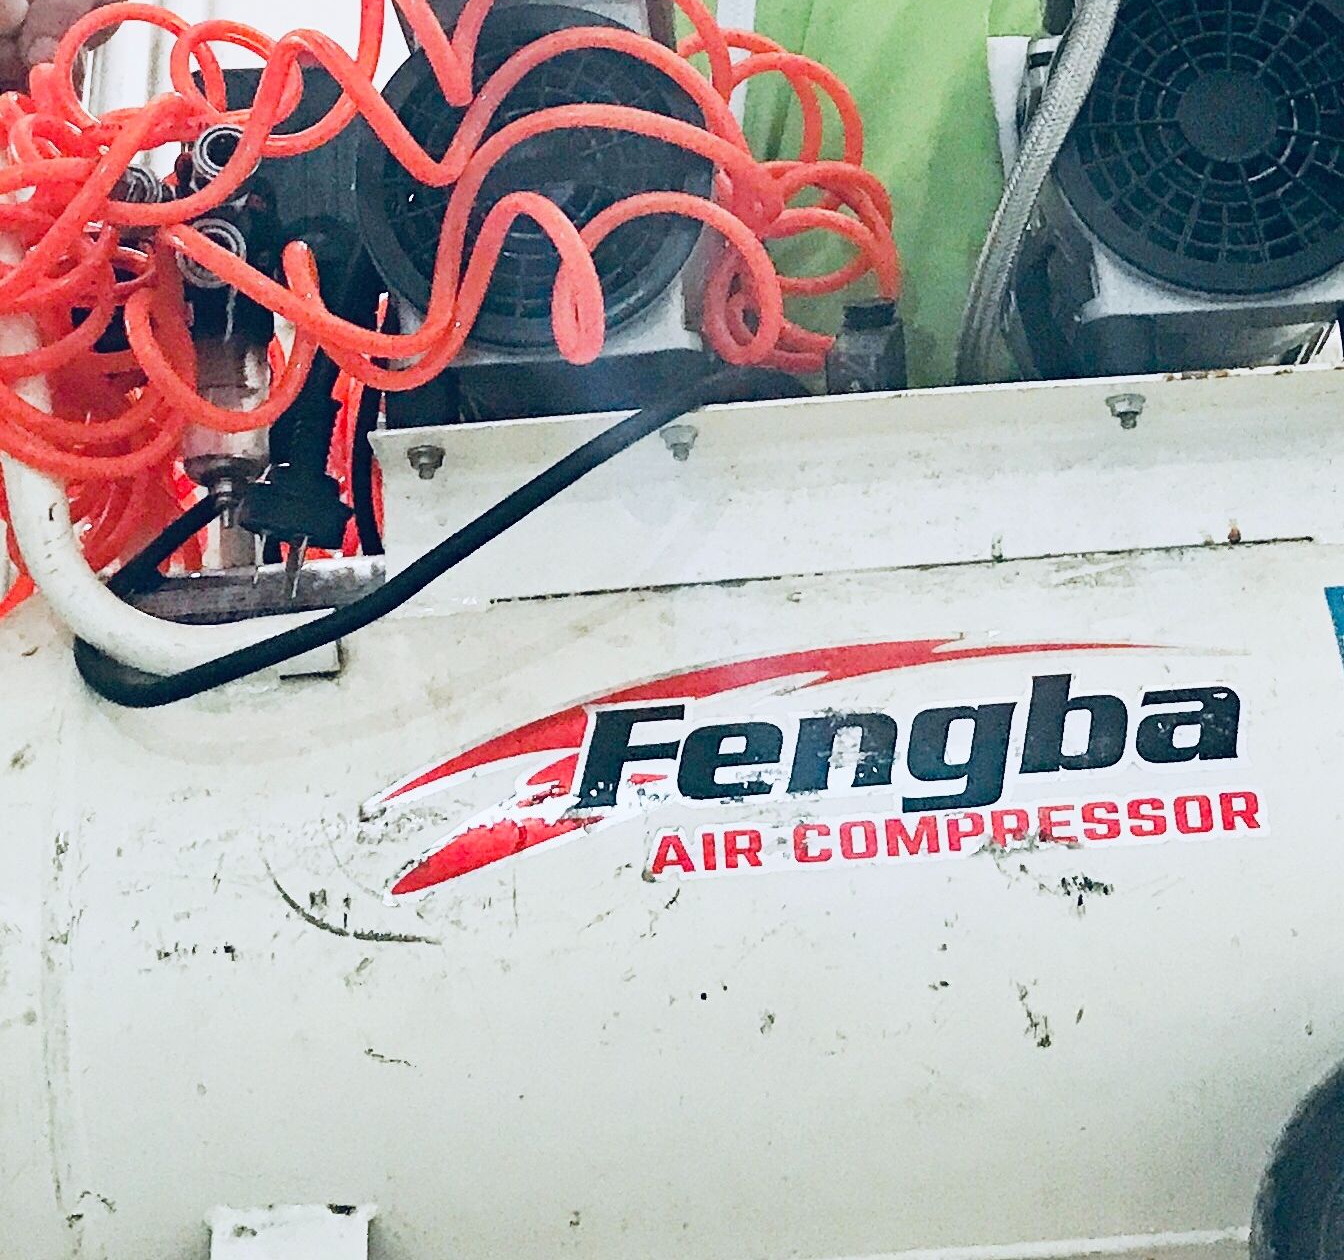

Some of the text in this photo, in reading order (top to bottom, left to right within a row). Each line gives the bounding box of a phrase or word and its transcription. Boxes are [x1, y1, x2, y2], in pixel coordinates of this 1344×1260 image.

[575, 673, 1241, 813] Fengba
[652, 790, 1261, 875] AIR COMPRESSOR
